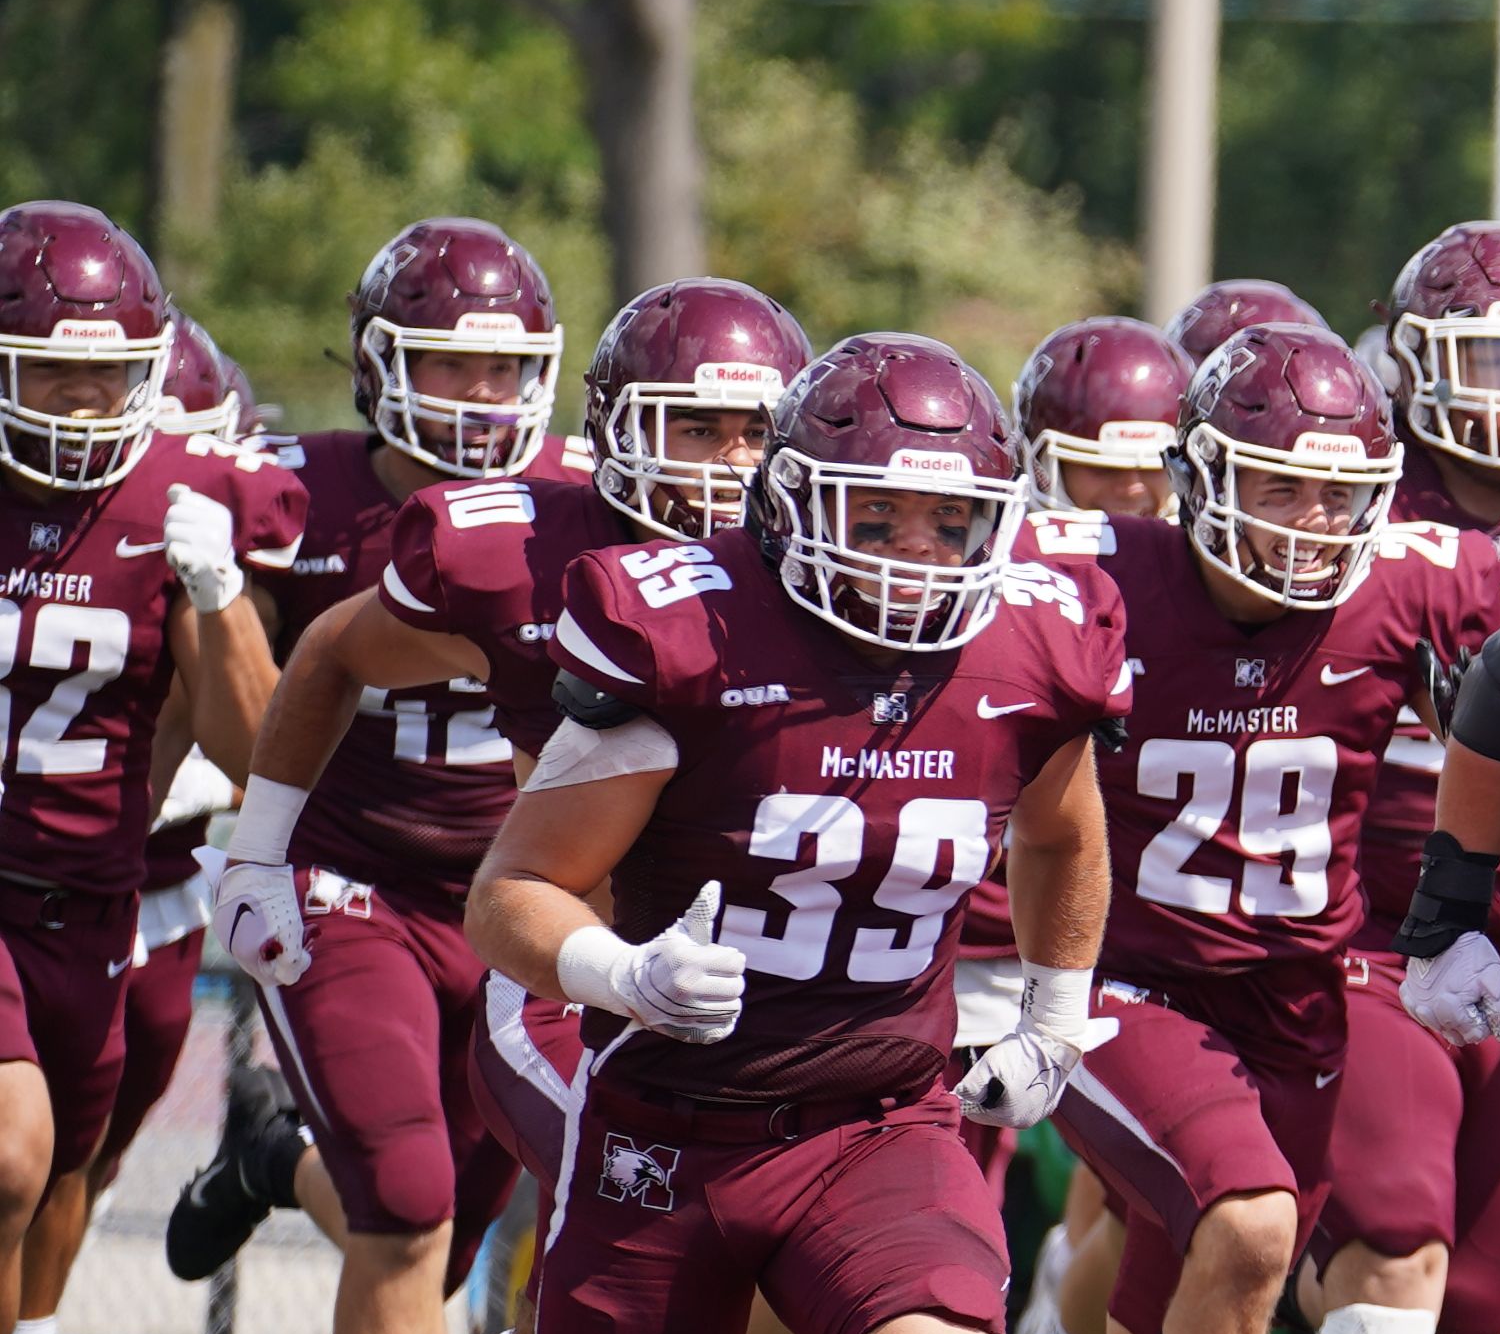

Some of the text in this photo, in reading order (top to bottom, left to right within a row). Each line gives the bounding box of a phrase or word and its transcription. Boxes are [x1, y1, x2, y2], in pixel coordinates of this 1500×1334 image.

[716, 367, 762, 382] Riddell
[901, 455, 963, 473] Riddell
[1305, 440, 1359, 455] Riddell
[444, 482, 536, 529] 10
[619, 545, 733, 609] 39
[0, 598, 130, 775] 2
[720, 683, 792, 707] OUA
[1186, 705, 1299, 734] McMASTER
[820, 745, 955, 780] McMASTER
[1135, 736, 1338, 918] 29
[717, 793, 991, 983] 39
